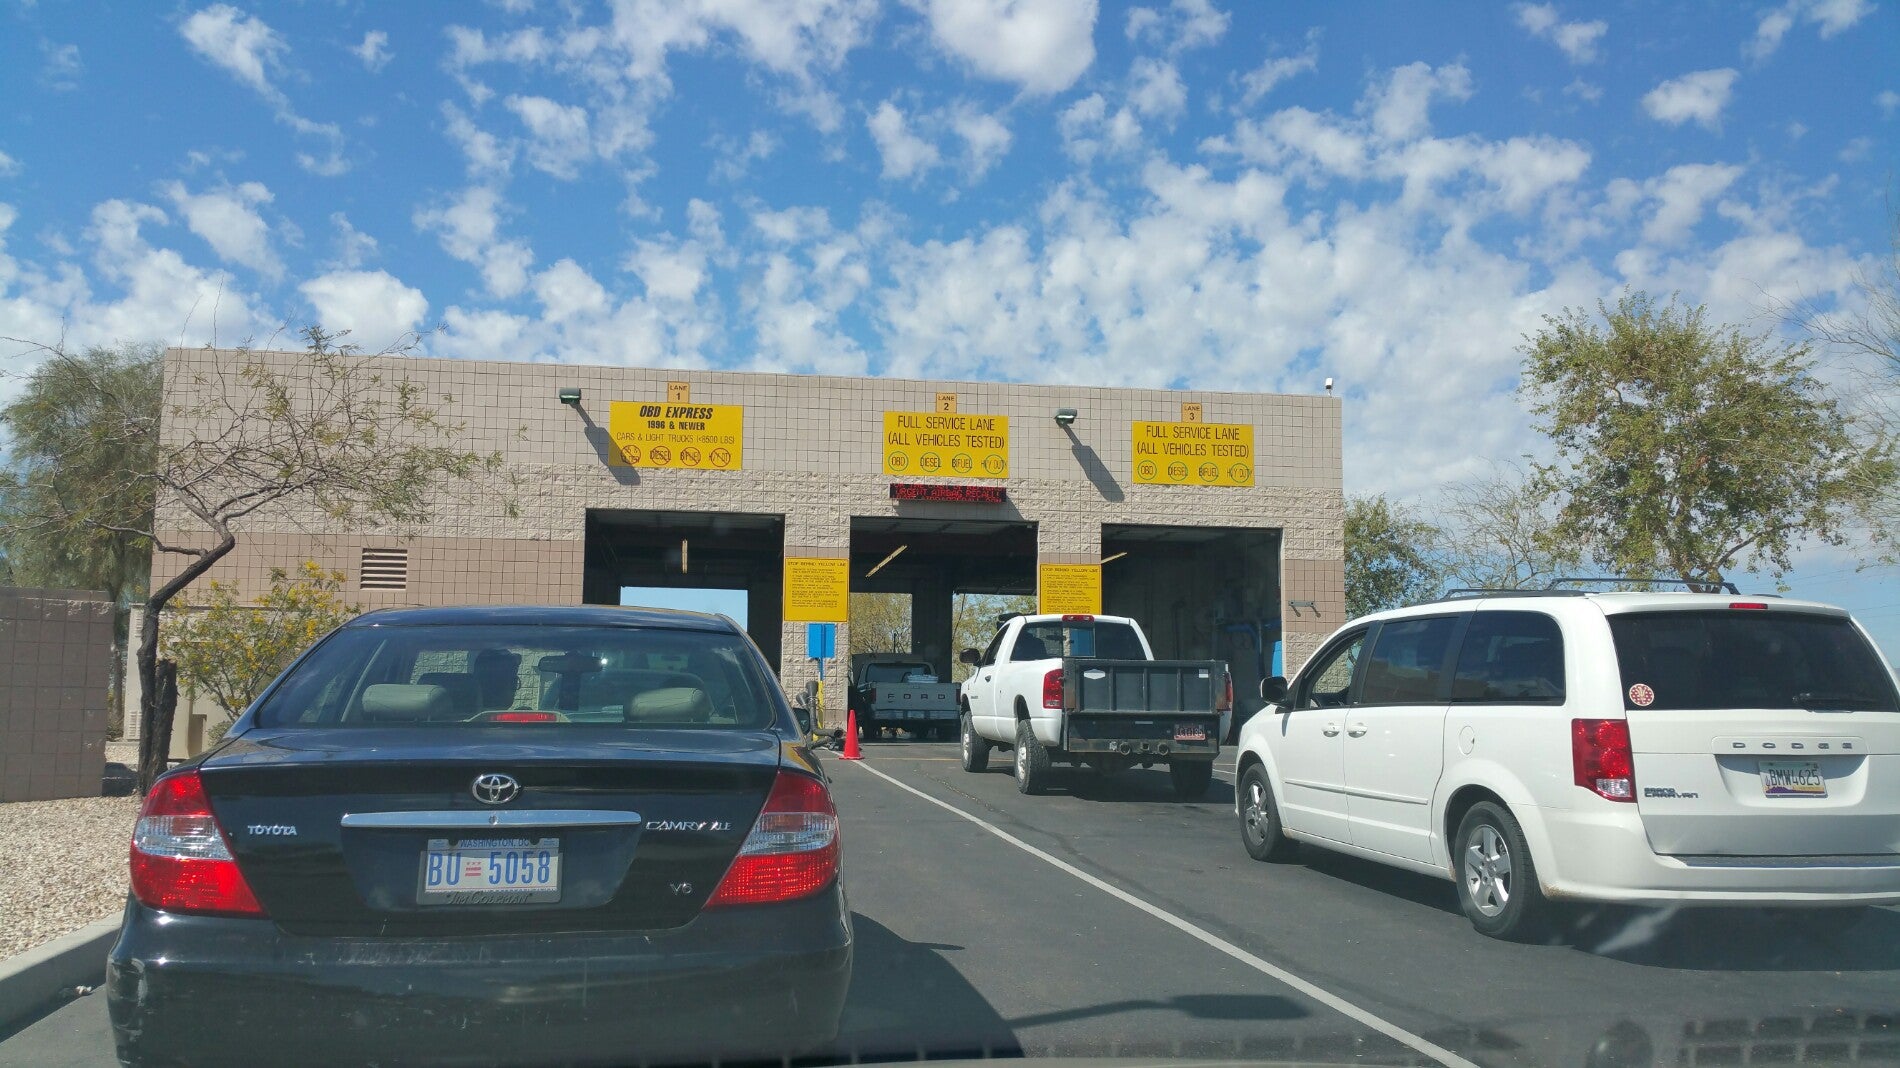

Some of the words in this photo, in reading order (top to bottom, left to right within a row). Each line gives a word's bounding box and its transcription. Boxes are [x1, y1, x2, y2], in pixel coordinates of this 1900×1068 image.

[640, 406, 661, 418] OBD
[666, 407, 713, 420] EXPRESS
[648, 421, 665, 429] 1996
[669, 422, 675, 430] &
[679, 422, 704, 430] NEWER
[898, 416, 921, 428] FULL
[926, 416, 966, 430] SERVICE
[970, 418, 995, 430] LANE
[616, 432, 634, 440] CARS
[646, 434, 664, 442] LIGHT
[668, 434, 694, 443] TRUCKS
[1146, 425, 1168, 438] FULL
[1174, 426, 1210, 440] SERVICE
[1216, 428, 1240, 440] LANE
[888, 432, 910, 446] (ALL
[916, 434, 960, 447] VEHICLES
[966, 435, 1004, 450] TESTED)
[1138, 442, 1158, 454] (ALL
[1162, 443, 1206, 456] VEHICLES
[1212, 444, 1249, 458] TESTED)
[892, 457, 906, 466] OBD
[920, 458, 941, 468] DIESEL
[1141, 466, 1154, 474] OBD
[1168, 466, 1188, 476] DIESEL
[931, 489, 962, 498] AIRBAG
[1769, 769, 1820, 786] BMW4625
[248, 824, 298, 836] TOYOTA
[646, 820, 707, 830] CAMRY
[710, 820, 731, 830] XLE
[428, 852, 462, 886] BU
[488, 850, 550, 884] 5058
[670, 883, 692, 896] V6
